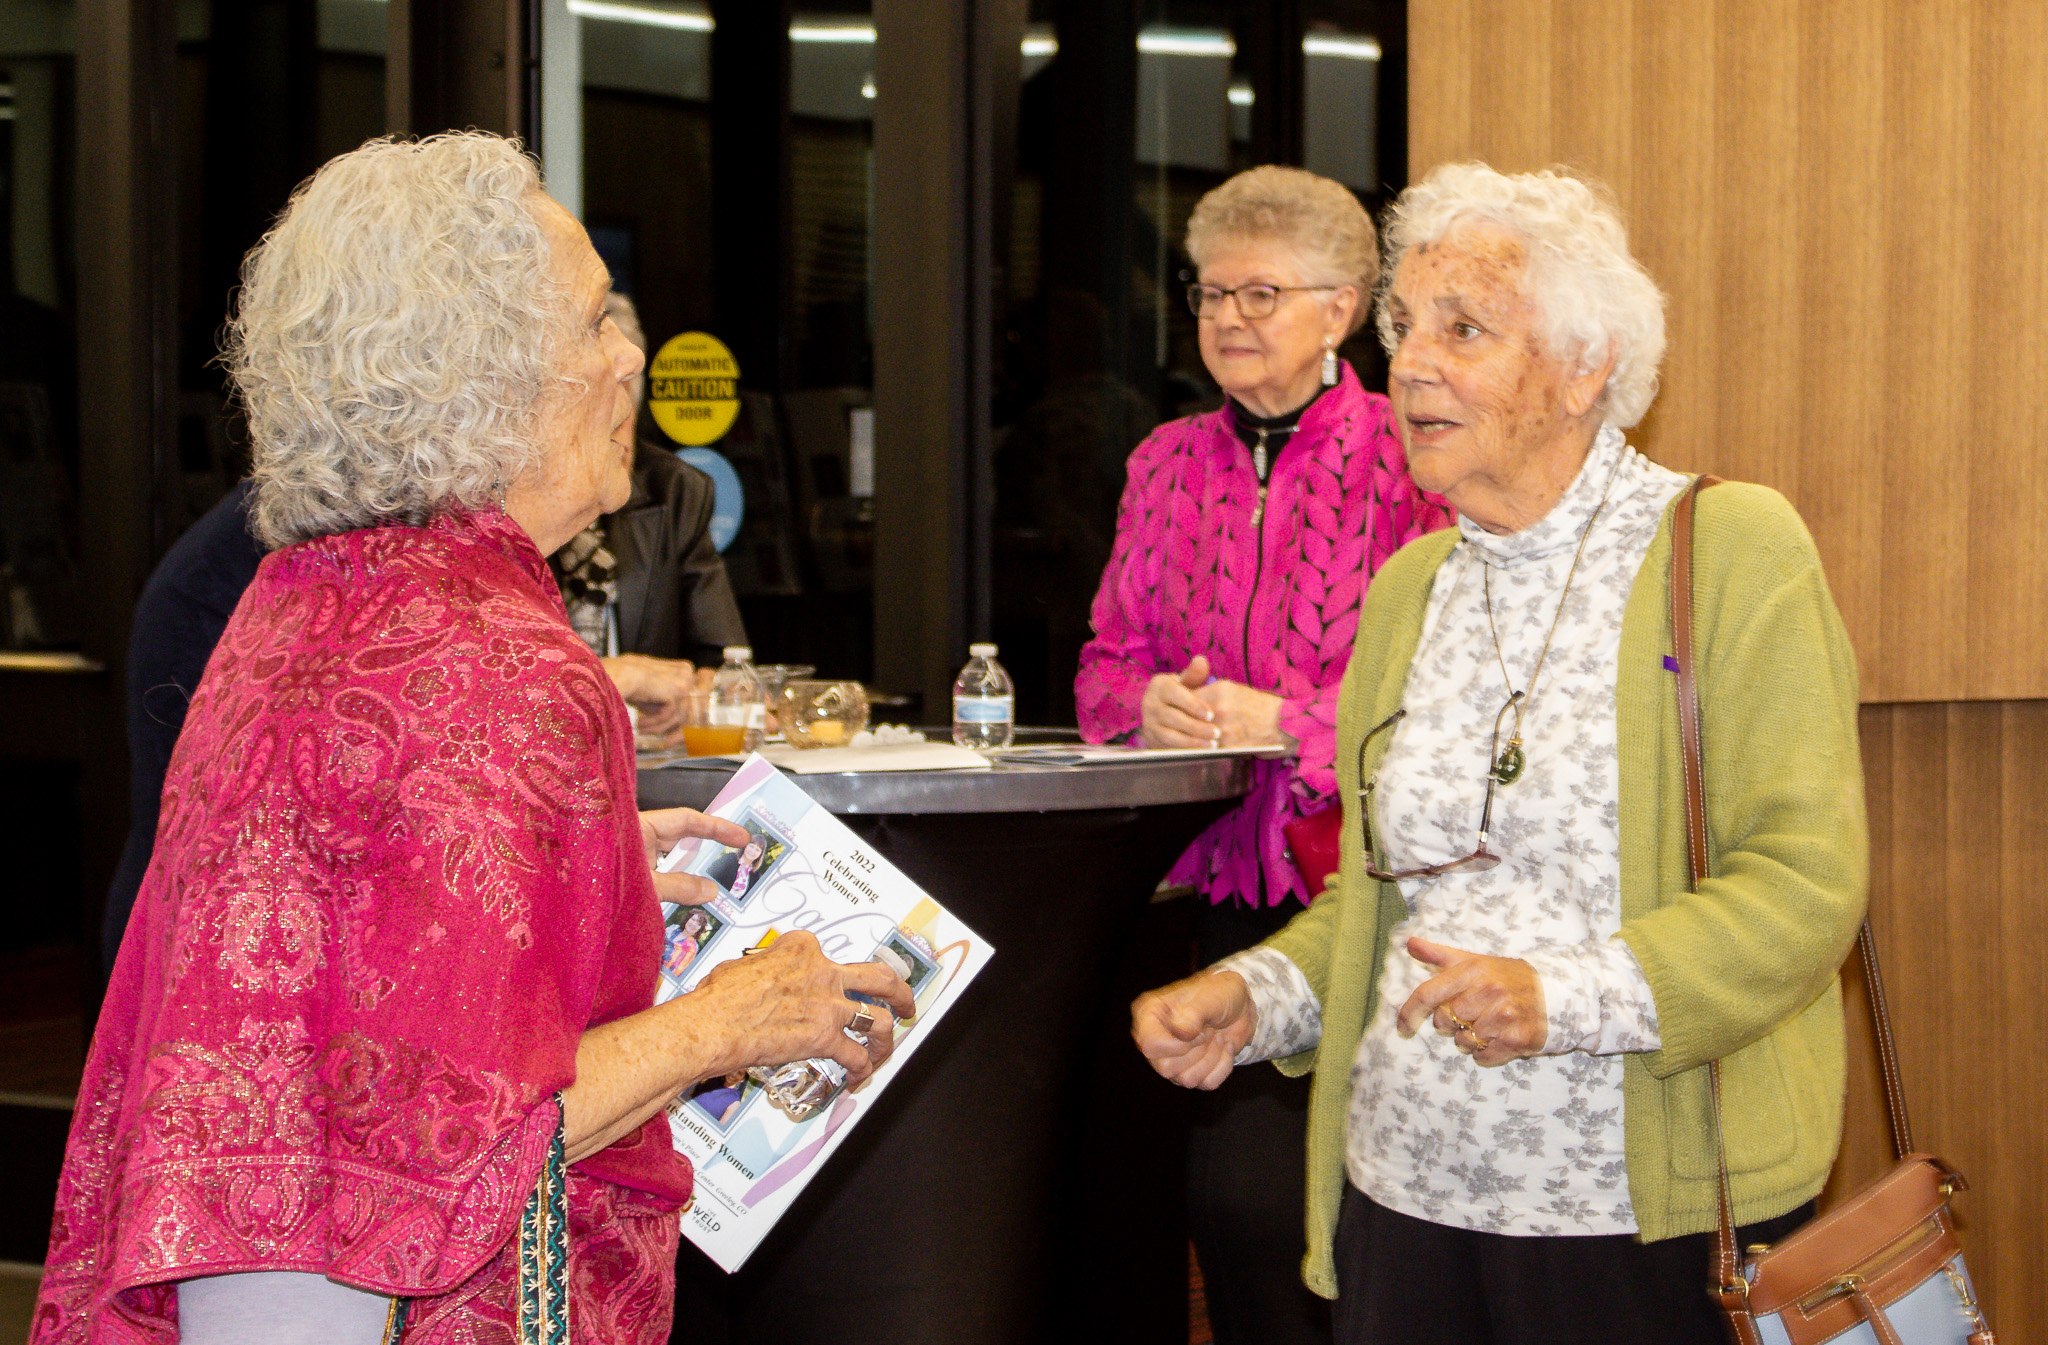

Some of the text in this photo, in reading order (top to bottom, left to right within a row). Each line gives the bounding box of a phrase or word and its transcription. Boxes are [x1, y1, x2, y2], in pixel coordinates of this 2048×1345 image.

[655, 358, 731, 371] AUTOMATIC
[652, 379, 736, 398] CAUTION
[675, 407, 712, 420] DOOR
[849, 849, 876, 874] 2022
[822, 850, 880, 904] Celebrating
[823, 869, 860, 905] Women
[736, 850, 899, 960] Gala
[665, 1103, 755, 1180] tstanding Women
[697, 1171, 715, 1188] Center
[736, 1205, 748, 1216] CO
[691, 1216, 712, 1234] TRUST
[693, 1204, 721, 1232] WELD
